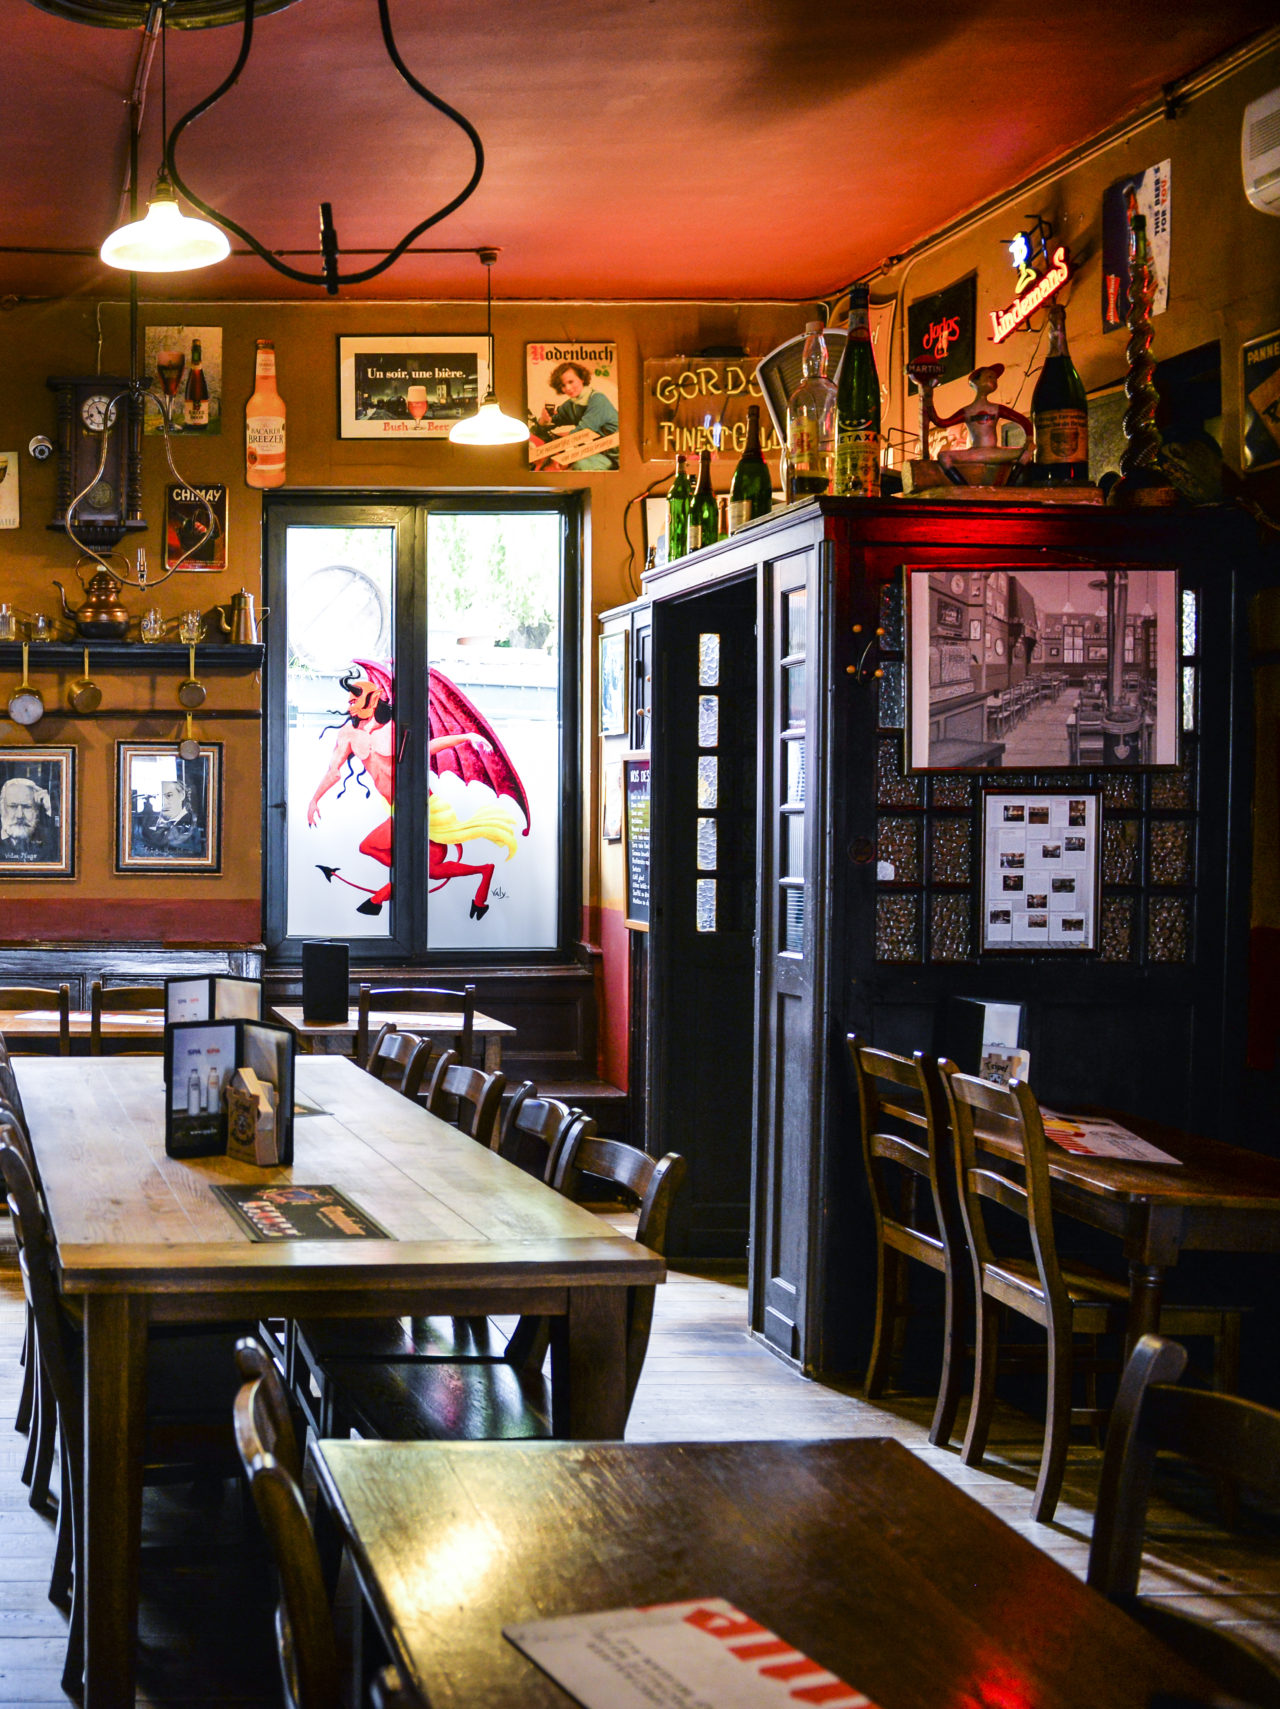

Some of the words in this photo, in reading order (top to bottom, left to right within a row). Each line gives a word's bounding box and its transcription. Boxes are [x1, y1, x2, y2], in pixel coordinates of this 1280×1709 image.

[989, 246, 1069, 344] Lindemans
[531, 345, 613, 364] Rodenbach
[367, 368, 384, 379] Un
[386, 369, 409, 380] soir,
[412, 371, 433, 379] une
[435, 368, 466, 379] bière.
[908, 364, 945, 375] MARTINI
[657, 367, 763, 404] GORDO
[248, 435, 284, 444] BREEZER
[172, 488, 223, 502] CHIMAY
